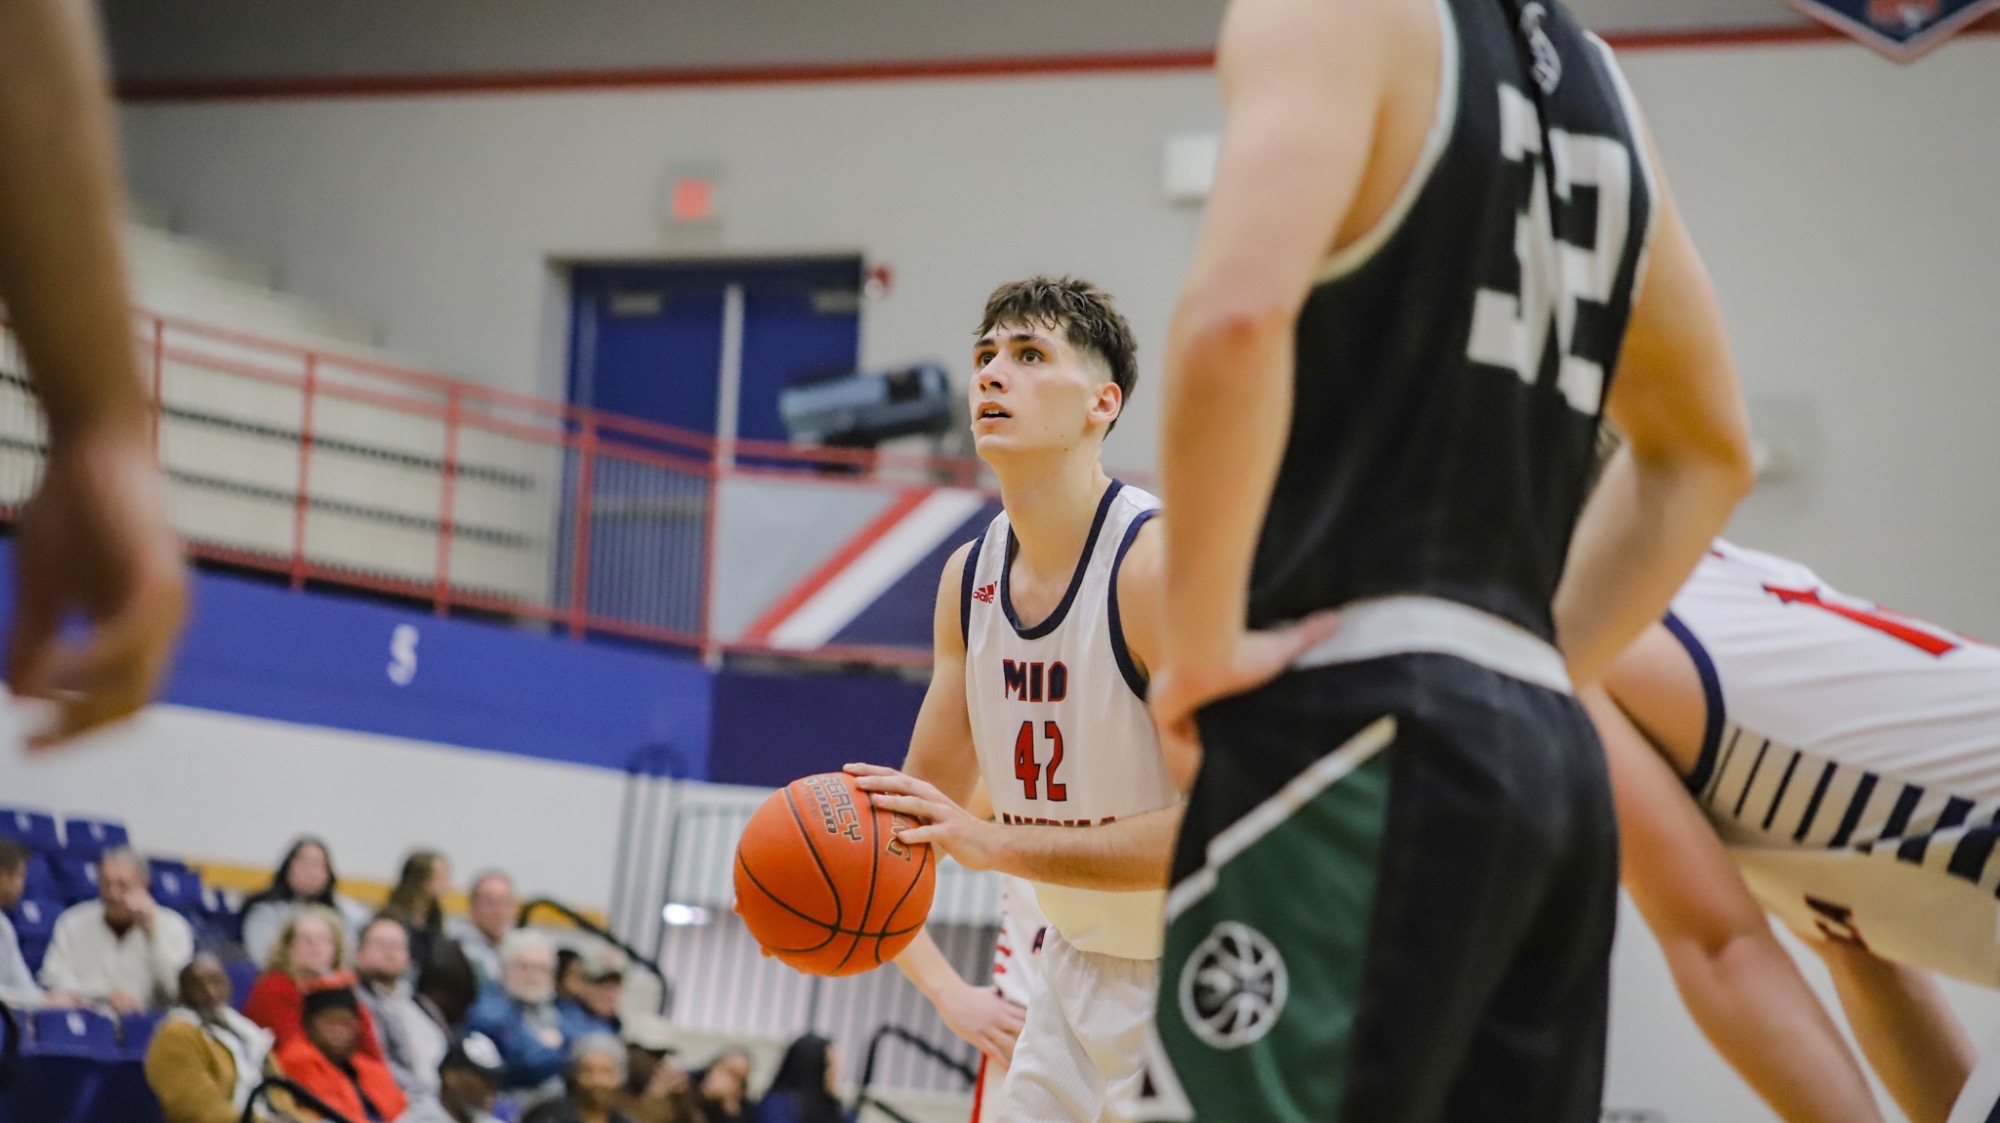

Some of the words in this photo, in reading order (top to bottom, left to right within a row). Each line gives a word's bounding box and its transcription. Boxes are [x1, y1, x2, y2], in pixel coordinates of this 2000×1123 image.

[1467, 81, 1631, 416] 32
[1002, 659, 1068, 702] MID
[1014, 720, 1067, 801] 42
